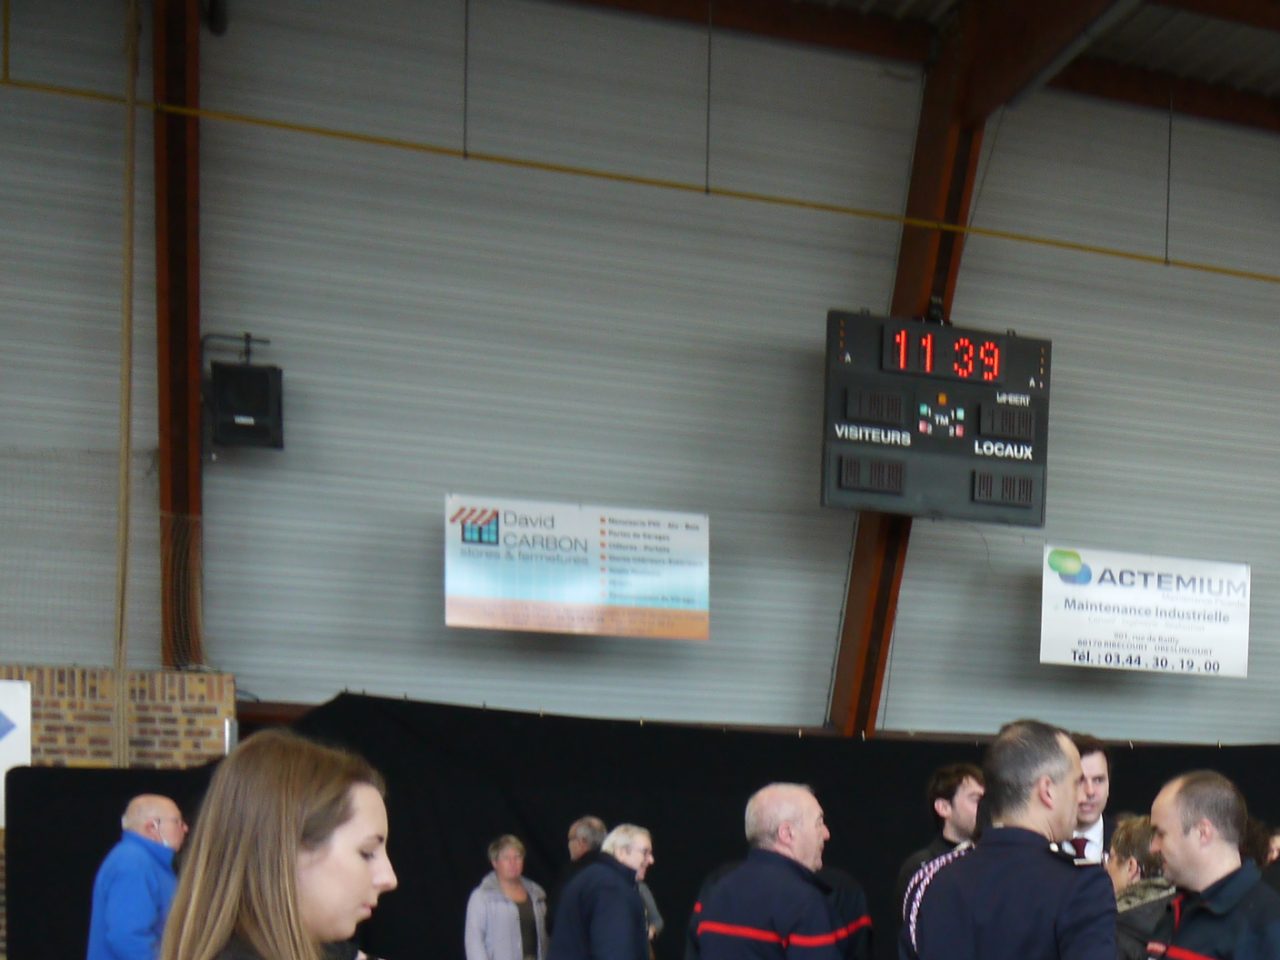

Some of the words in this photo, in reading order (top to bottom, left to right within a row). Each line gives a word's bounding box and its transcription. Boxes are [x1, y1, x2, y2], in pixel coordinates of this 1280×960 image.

[953, 337, 999, 380] 39
[835, 424, 911, 446] VISITEURS
[974, 440, 1032, 461] LOCAUX
[503, 511, 555, 529] David
[503, 531, 588, 553] CARBON
[1097, 568, 1247, 598] ACTEMIUM
[1064, 598, 1152, 616] Maintenance
[1155, 607, 1230, 624] Industrielle
